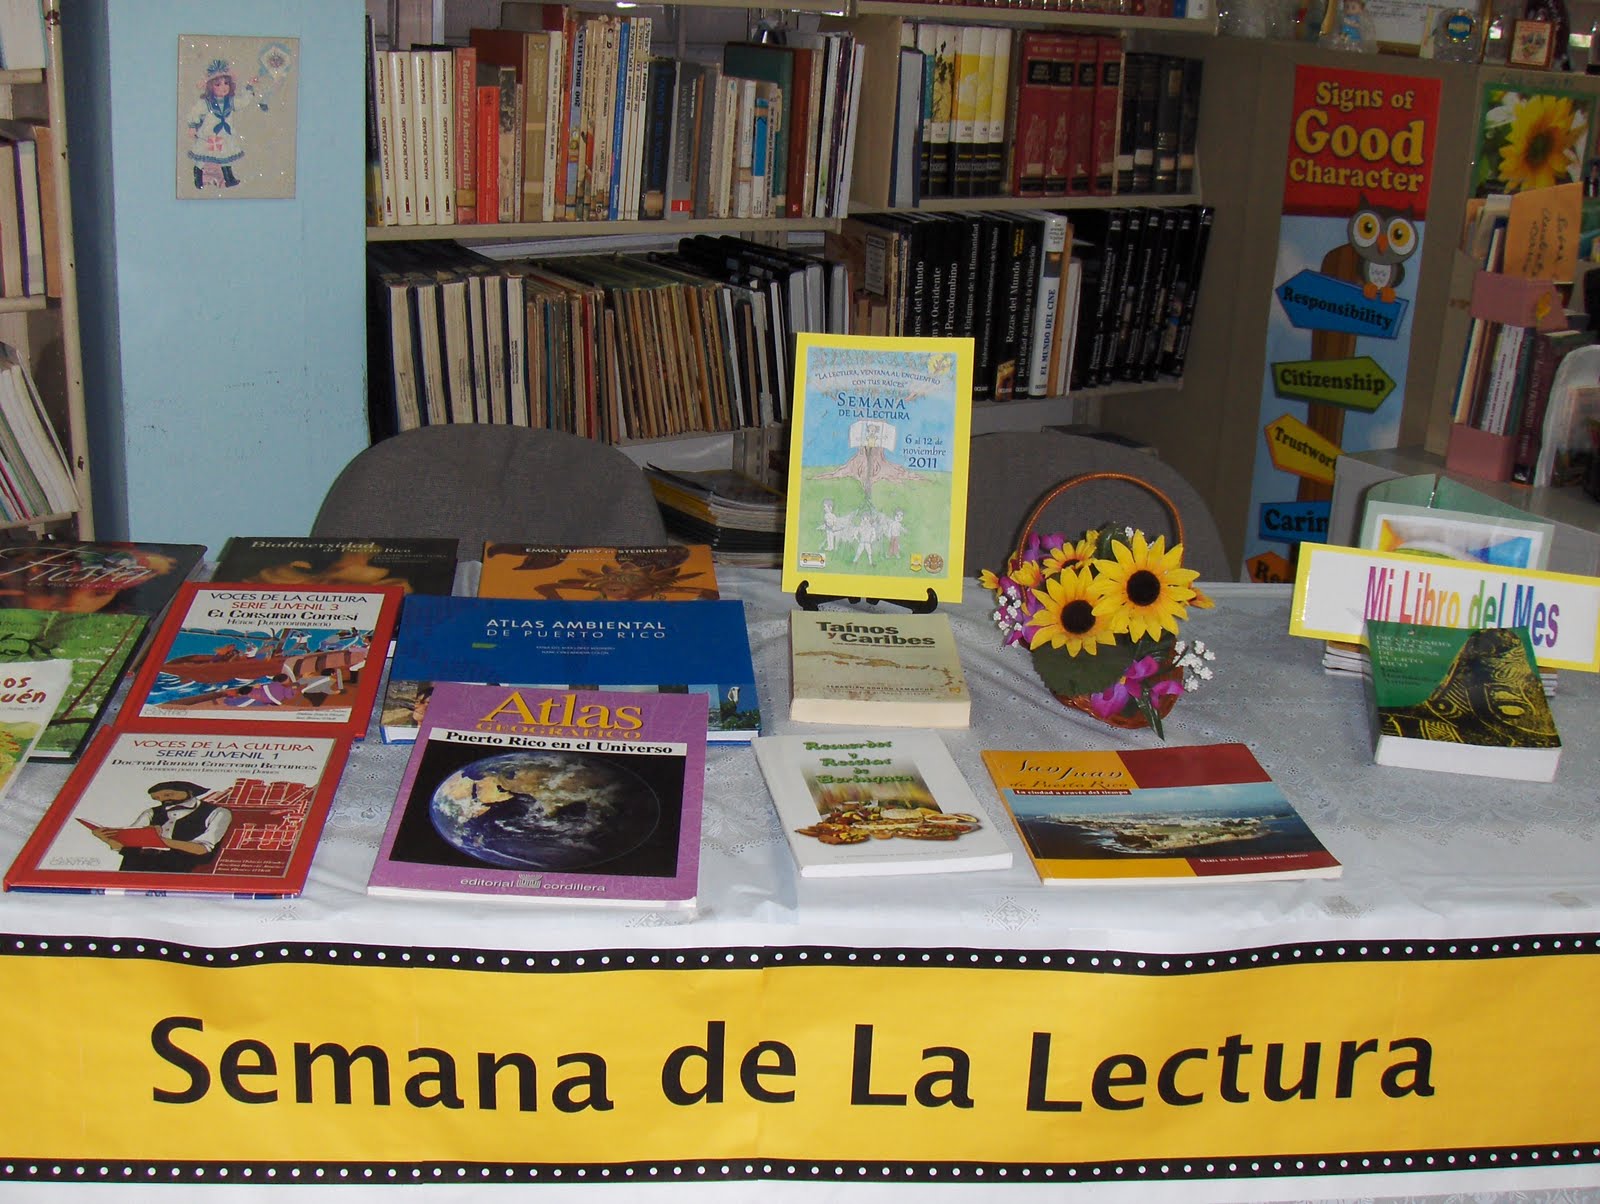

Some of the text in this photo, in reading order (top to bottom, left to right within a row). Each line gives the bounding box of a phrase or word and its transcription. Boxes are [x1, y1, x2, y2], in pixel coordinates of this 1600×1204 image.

[574, 33, 585, 87] BIOGRAFIAS
[1316, 81, 1415, 112] Signs of
[461, 59, 471, 170] Readings in American
[1295, 108, 1425, 166] Good
[1289, 158, 1425, 192] Character
[990, 227, 999, 250] Mundo
[1025, 245, 1037, 288] Civilización
[914, 261, 925, 295] Mundo
[964, 223, 980, 330] Enigmas de la Humanidad
[930, 267, 942, 318] Occidente
[944, 262, 959, 330] Precolombino
[1024, 289, 1033, 297] la
[914, 297, 923, 313] del
[1006, 261, 1021, 343] Razas del Mundo
[1283, 286, 1393, 331] Responsibility
[1021, 325, 1030, 336] del
[1040, 288, 1056, 376] EL MUNDO DEL CINE
[1019, 337, 1029, 357] Edad
[1019, 358, 1027, 366] la
[901, 372, 941, 385] ENCUENTRO
[1018, 367, 1026, 377] De
[1280, 368, 1386, 395] Citizenship
[837, 392, 906, 410] SEMANA
[839, 408, 910, 420] DE LA LECTURA
[905, 434, 912, 444] 6
[923, 437, 933, 445] 12
[903, 446, 946, 456] noviembre
[908, 457, 937, 469] 2011
[251, 541, 376, 549] Biodiversidad
[210, 592, 368, 603] VOCES DE LA CULTURA
[232, 602, 339, 611] SERIE JUVENIL 3
[1363, 566, 1560, 648] Mi Libro del Mes
[486, 619, 666, 630] ATLAS AMBIENTAL
[816, 621, 899, 635] Taínos
[486, 629, 666, 639] DE PUERTO RICO
[827, 632, 837, 640] y
[840, 632, 936, 646] Caribes
[1, 676, 32, 689] os
[0, 688, 47, 704] uén
[478, 691, 644, 731] Atlas
[133, 740, 314, 752] VOCES DE LA CULTURA
[445, 731, 673, 754] Puerto Rico en el Universo
[803, 739, 892, 750] Recuerdos
[156, 750, 280, 760] SERIE JUVENIL 1
[853, 767, 869, 775] de
[1020, 759, 1123, 781] San Juan
[1032, 780, 1085, 788] Puerto
[1090, 781, 1128, 789] Rico
[460, 877, 606, 892] editorial cordillera
[150, 1015, 1436, 1113] Semana de La Lectura
